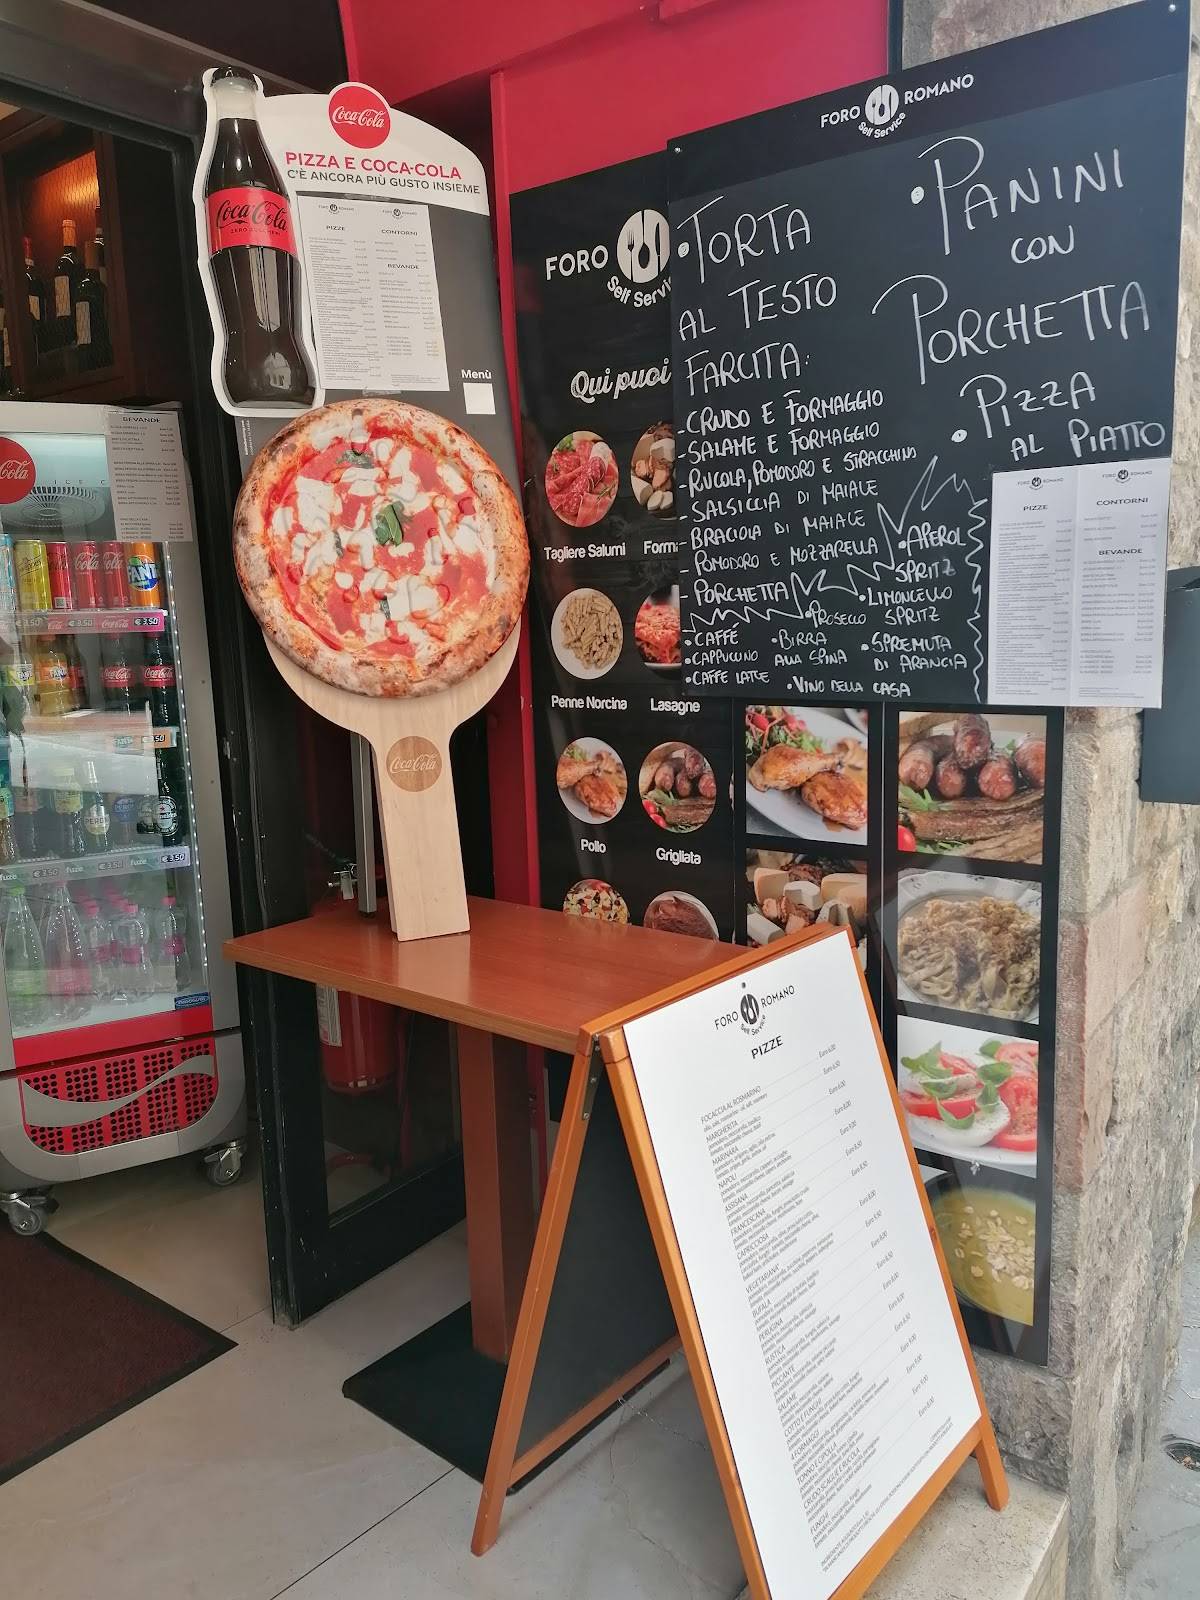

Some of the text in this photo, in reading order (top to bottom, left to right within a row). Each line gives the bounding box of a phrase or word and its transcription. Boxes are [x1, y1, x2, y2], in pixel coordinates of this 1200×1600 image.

[820, 74, 974, 128] FORO ROMANO
[332, 105, 385, 129] Coca-Cola
[858, 113, 906, 138] Self Service
[286, 151, 461, 179] PIZZA E COCA-COLA
[311, 171, 363, 185] ANCORA
[367, 171, 386, 186] PIÙ
[390, 178, 429, 190] GUSTO
[433, 182, 481, 194] INSIEME
[918, 136, 1123, 255] PANINI
[217, 199, 288, 232] Coca-Cola
[678, 196, 811, 283] TORTA
[1011, 225, 1075, 264] CON
[545, 244, 609, 281] FORO
[607, 275, 631, 304] Self
[679, 275, 837, 341] AL TESTO
[872, 275, 1149, 385] PORCHETTA
[461, 368, 492, 380] Menù
[570, 358, 672, 404] Qui puoi
[686, 390, 883, 436] CRUDO E FORMAGGIO
[960, 371, 1095, 438] PIZZA
[687, 422, 880, 464] SALAME E FORMAGGIO
[1011, 419, 1166, 461] AL PIATTO
[752, 459, 815, 486] POMODORO
[822, 457, 832, 474] E
[691, 479, 878, 523] SALSICCIA DI MAIALE
[1096, 497, 1149, 506] CONTORNI
[690, 509, 865, 550] BRACIOLA DI MAIALE
[903, 525, 967, 556] APEROL
[544, 542, 626, 563] Tagliere Salumi
[694, 537, 878, 576] POMODORO E MOZZARELLA
[1099, 548, 1143, 556] BEVANDE
[895, 558, 956, 583] SPRITZ
[694, 578, 789, 606] PORCHETTA
[867, 586, 953, 606] LIMONCELLO
[809, 600, 867, 628] PROSECCO
[885, 606, 941, 625] SPRITZ
[778, 628, 827, 648] BIRRA
[871, 632, 952, 652] SPREMUTA
[775, 649, 848, 666] ALLA SPINA
[874, 653, 968, 671] DI ARANCIA
[791, 676, 911, 697] VINO DELLA CASA
[551, 695, 627, 710] Penne Norcina
[650, 697, 700, 715] Lasagne
[390, 753, 438, 774] Coca-Cola
[580, 838, 606, 854] Pollo
[655, 848, 701, 865] Grigliata
[714, 985, 795, 1030] FORO ROMANO
[751, 1035, 784, 1060] PIZZE
[706, 1122, 737, 1141] MARGHERITA
